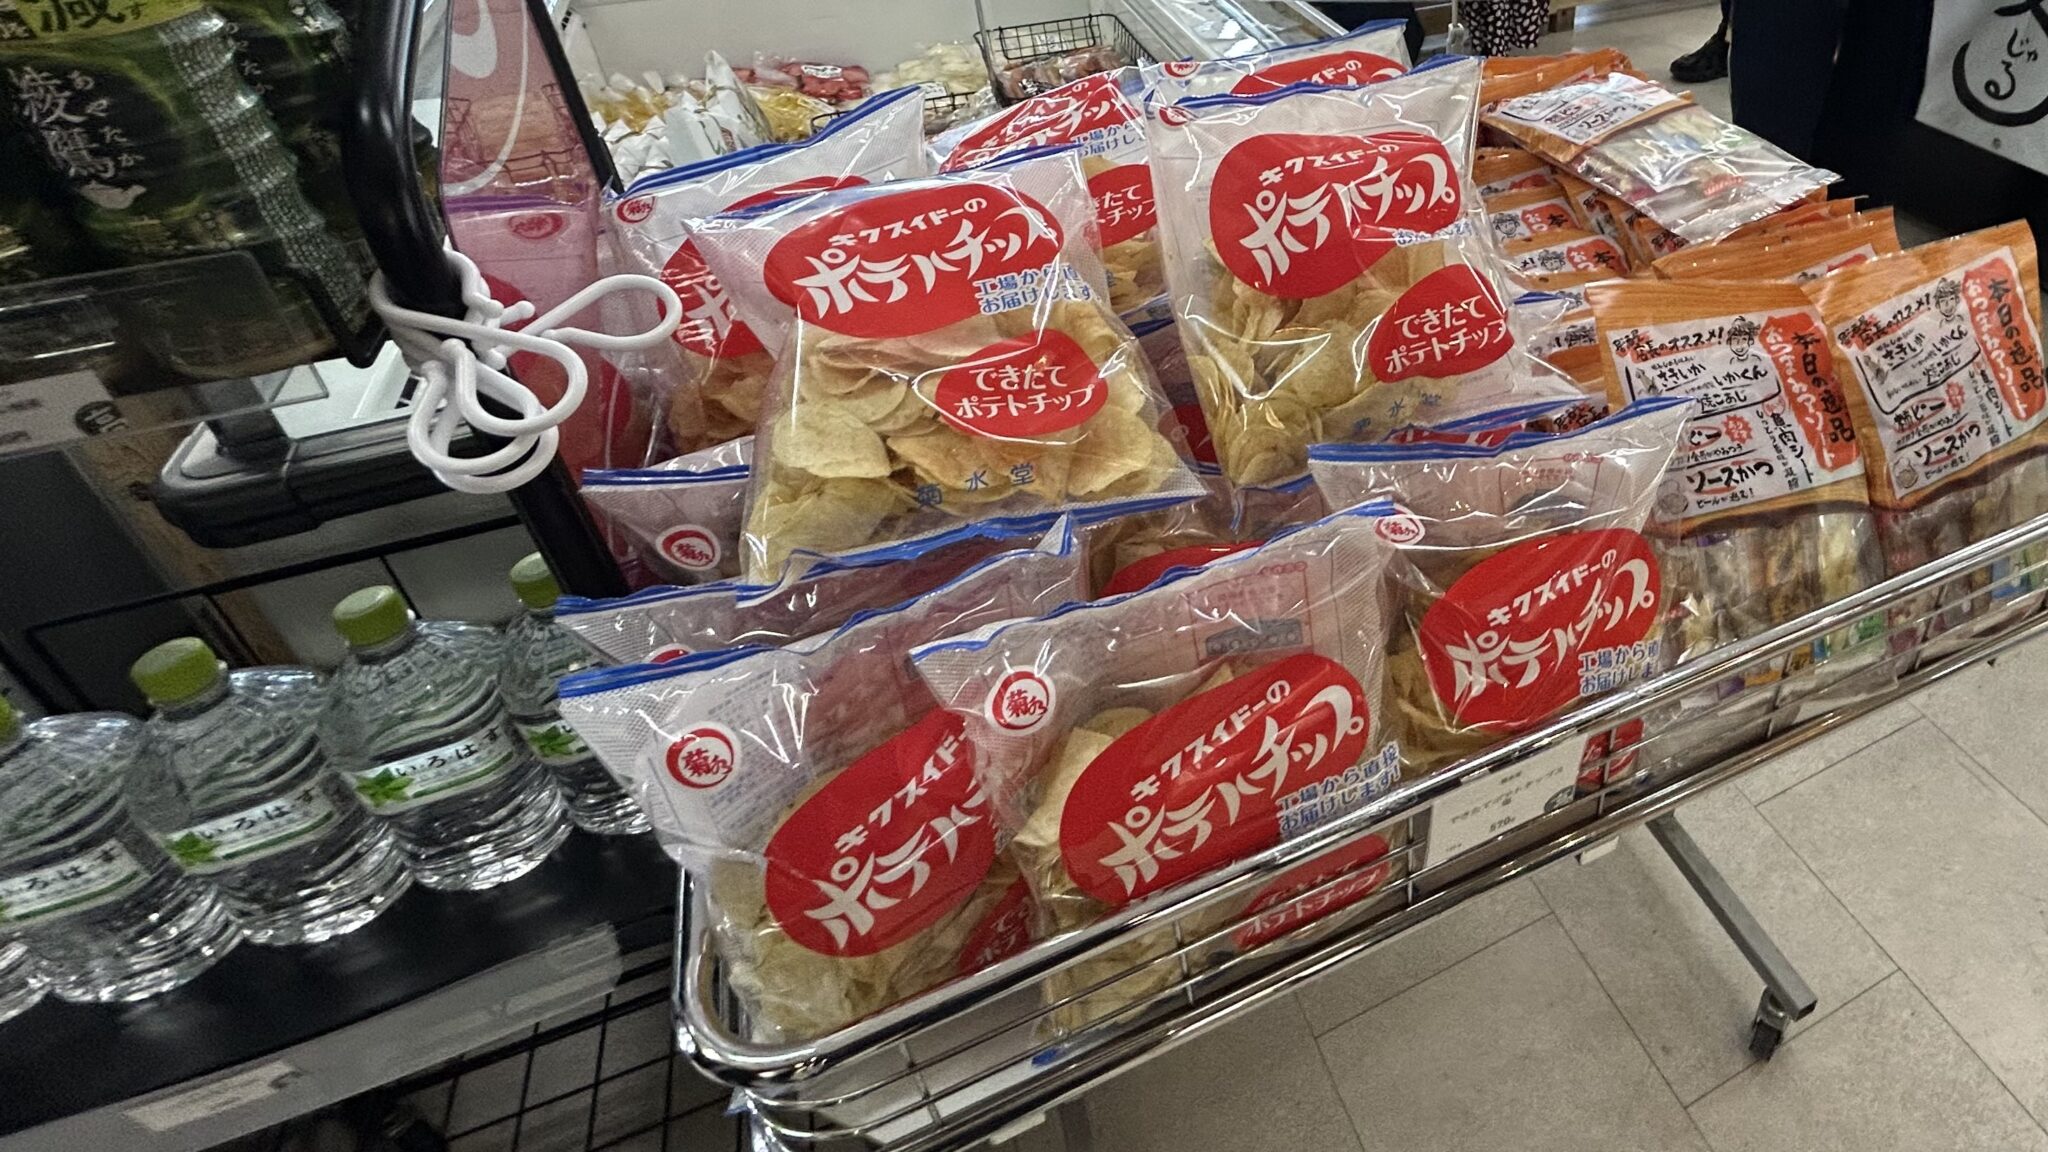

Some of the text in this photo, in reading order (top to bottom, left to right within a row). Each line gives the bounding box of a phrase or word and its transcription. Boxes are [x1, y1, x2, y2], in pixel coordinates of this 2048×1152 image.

[1258, 144, 1400, 187] キクスイドーの
[828, 197, 988, 248] キクスイドーの
[1394, 295, 1486, 339] できたて
[969, 363, 1068, 391] できたて
[953, 383, 1096, 419] ポテトチップ
[1913, 423, 1981, 467] ソースかつ
[1686, 460, 1775, 495] ソースかつ
[1486, 548, 1618, 627] キクスイドーの
[1130, 679, 1292, 803] キクスイドーの
[1278, 741, 1400, 814] 工場から直接
[1280, 765, 1402, 833] お届けします!
